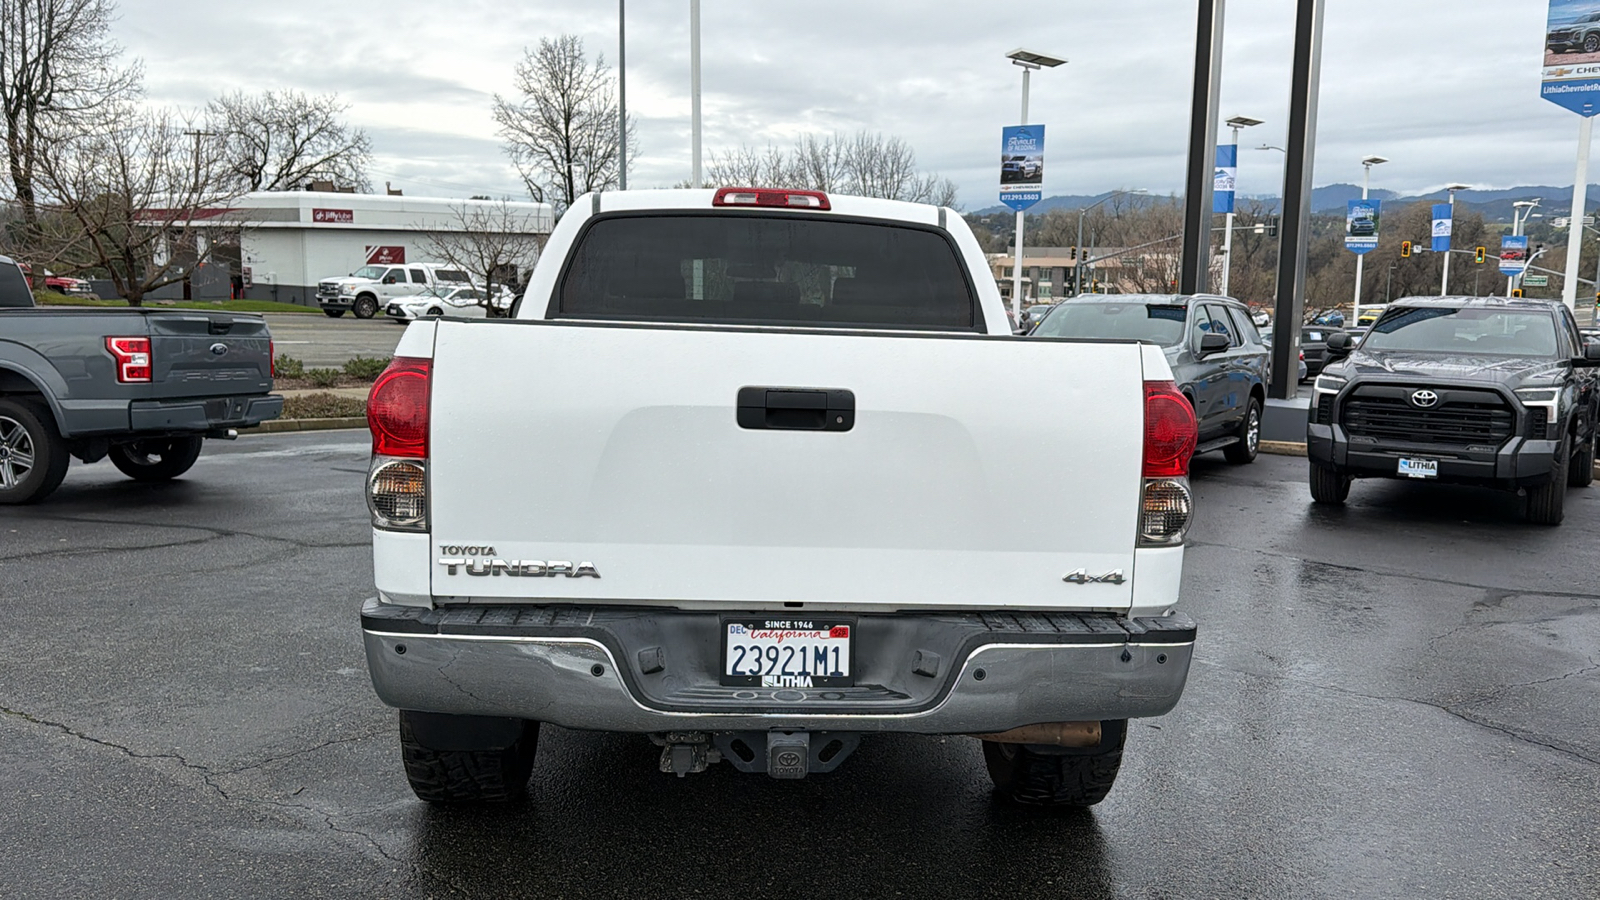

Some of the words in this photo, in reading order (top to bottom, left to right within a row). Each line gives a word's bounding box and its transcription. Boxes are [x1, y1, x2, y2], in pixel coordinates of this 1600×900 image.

[1007, 138, 1036, 146] CHEVROLET
[1001, 193, 1039, 201] 877.293.5503
[1408, 461, 1436, 470] LITHIA
[439, 545, 497, 557] TOYOTA
[438, 558, 602, 579] TUNDRA
[1062, 568, 1127, 585] 4x4
[730, 625, 747, 635] DEC
[765, 621, 791, 629] SINCE
[794, 621, 813, 629] 1946
[750, 629, 824, 643] California
[731, 645, 844, 676] 23921M1
[773, 675, 813, 687] LITHIA
[774, 766, 804, 774] TOYOTA
